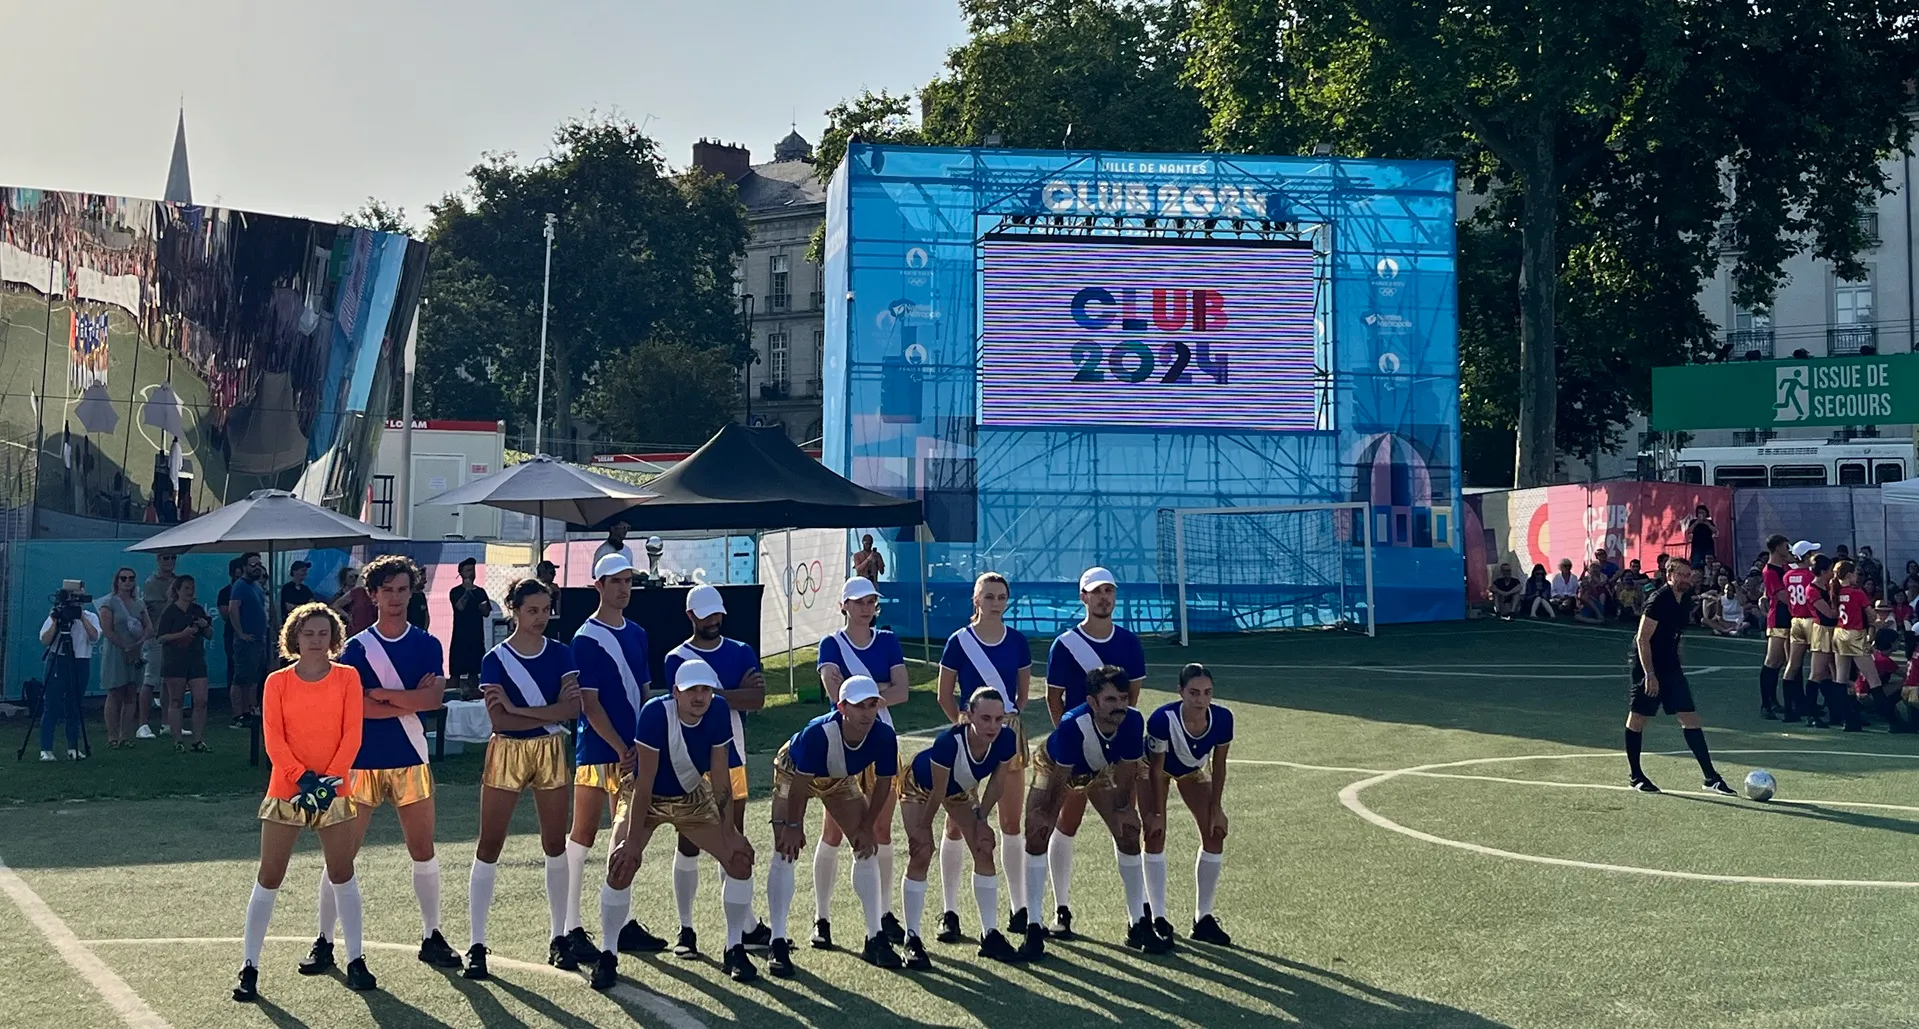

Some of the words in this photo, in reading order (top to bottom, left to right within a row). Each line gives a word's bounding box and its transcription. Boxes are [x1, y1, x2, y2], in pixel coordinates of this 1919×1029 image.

[1101, 163, 1135, 173] VILLE
[1139, 164, 1155, 173] DE
[1159, 164, 1207, 175] NANTES
[1042, 180, 1152, 216] CLUB
[1157, 184, 1268, 218] 2024
[1070, 286, 1229, 331] CLUB
[1070, 340, 1229, 384] 2024
[1814, 365, 1861, 389] ISSUE
[1867, 364, 1890, 387] DE
[1814, 393, 1892, 417] SECOURS
[390, 420, 428, 429] LOAM
[1583, 504, 1627, 529] CLUB
[1788, 584, 1807, 606] 38
